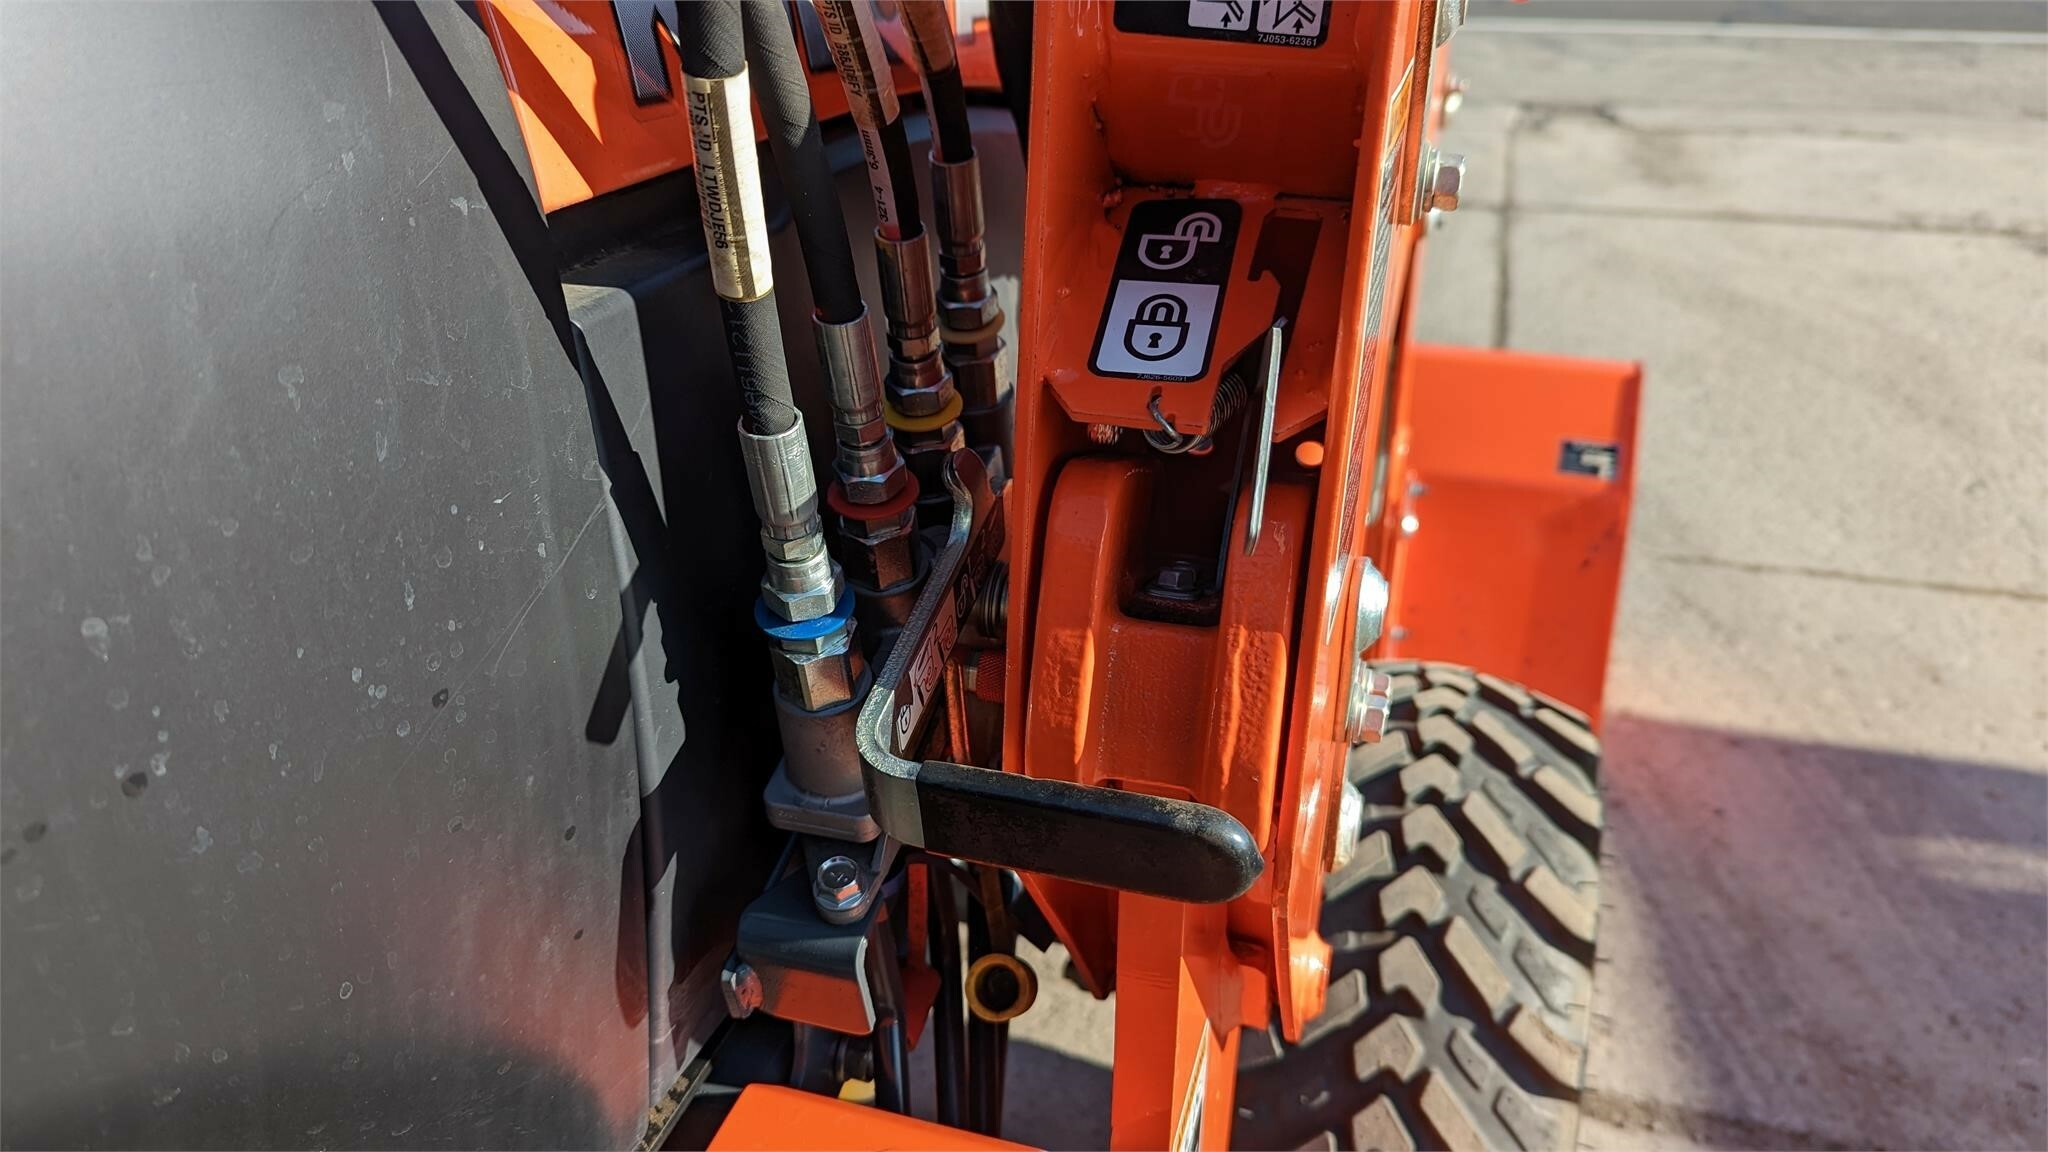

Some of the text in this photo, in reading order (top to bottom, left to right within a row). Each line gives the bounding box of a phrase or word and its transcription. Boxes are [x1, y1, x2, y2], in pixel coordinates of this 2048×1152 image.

[1258, 33, 1318, 47] 7J053-62361
[692, 91, 708, 127] PTS
[874, 185, 889, 222] 321-4
